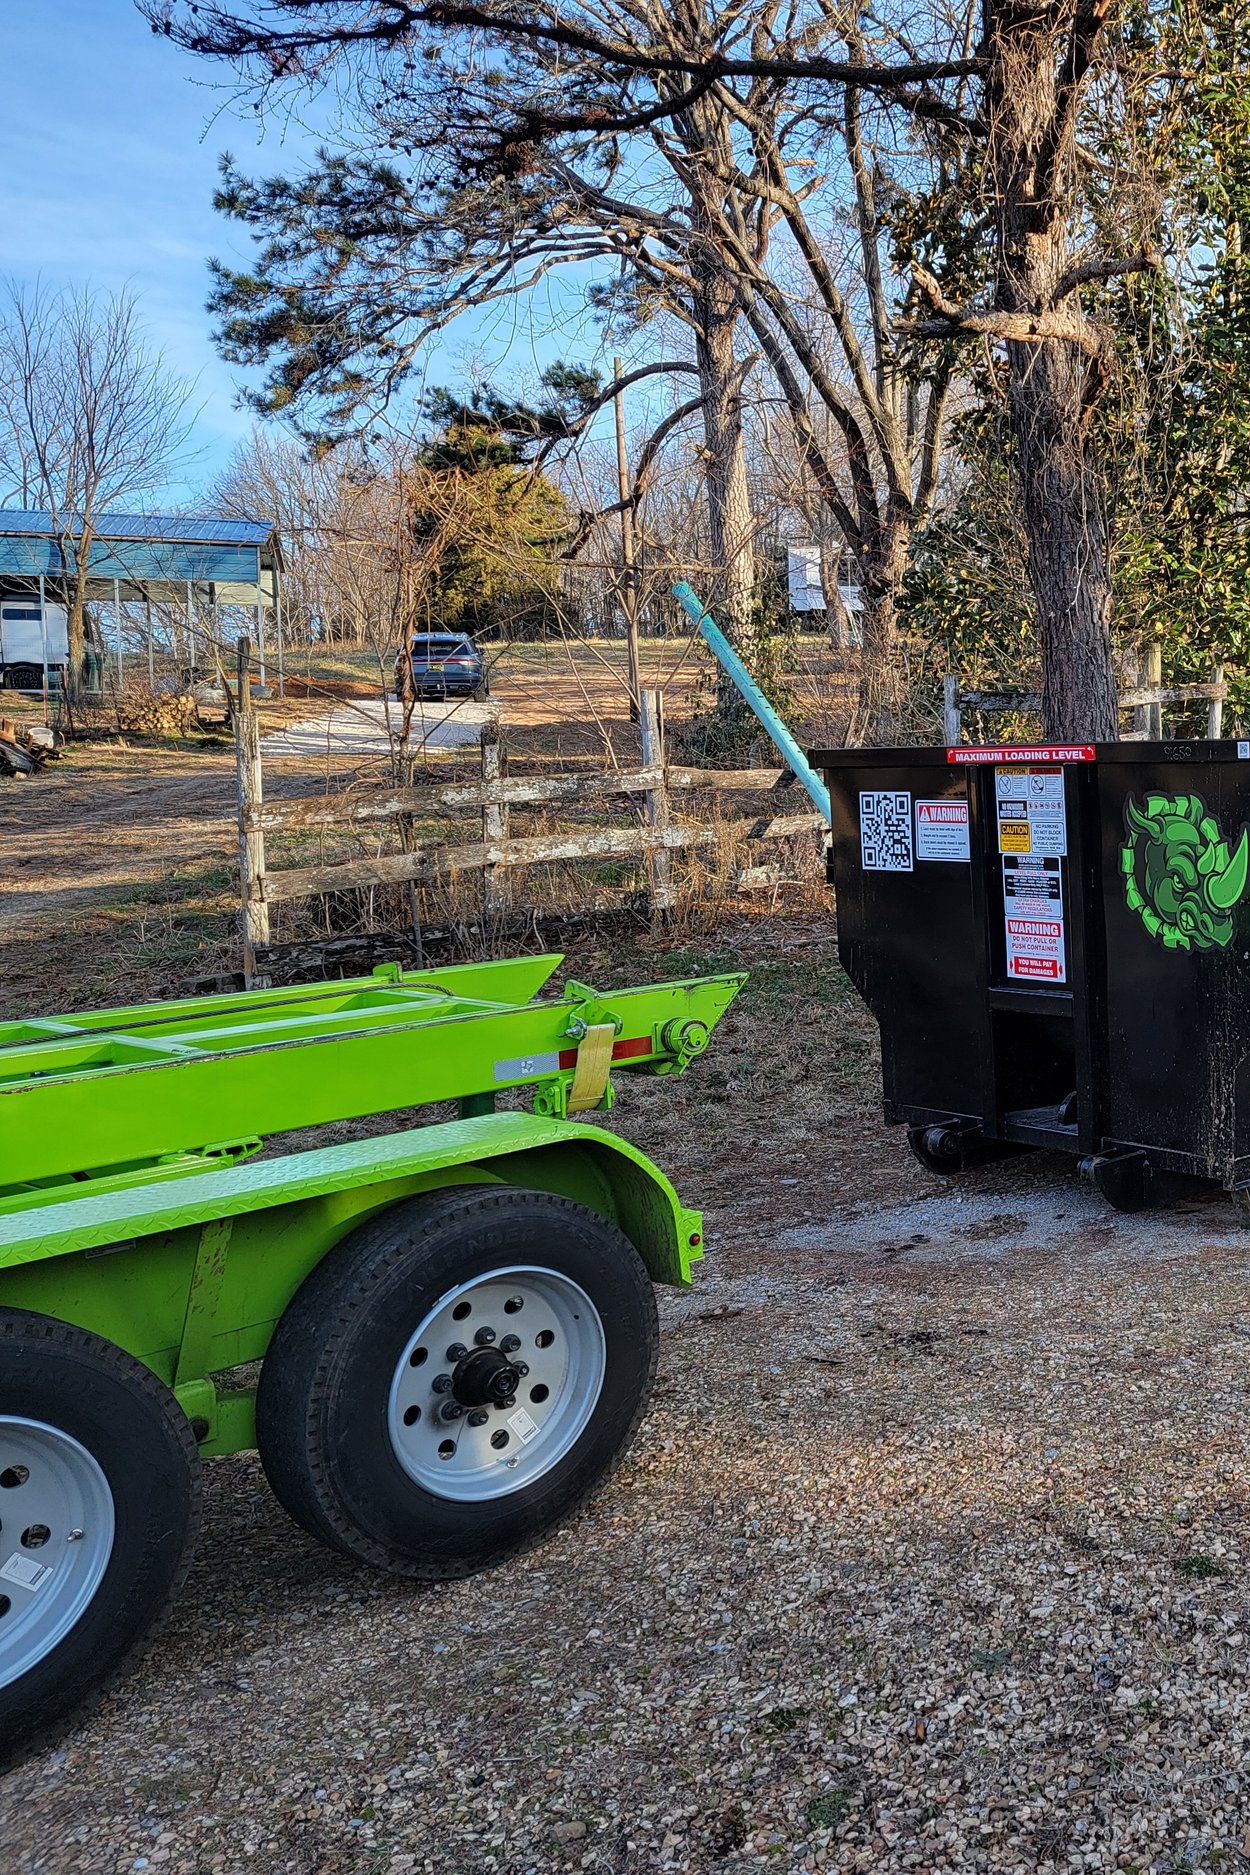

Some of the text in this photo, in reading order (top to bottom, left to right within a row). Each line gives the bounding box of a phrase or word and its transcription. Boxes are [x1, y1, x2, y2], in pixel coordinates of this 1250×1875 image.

[955, 750, 1085, 762] MAXIMUM LOADING LEVEL
[930, 807, 967, 822] WARNING
[1001, 825, 1028, 834] CAUTION
[1017, 856, 1045, 865] WARNING
[1009, 922, 1059, 936] WARNING
[1026, 944, 1059, 952] CONTAINER
[1029, 968, 1054, 976] DAMAGES
